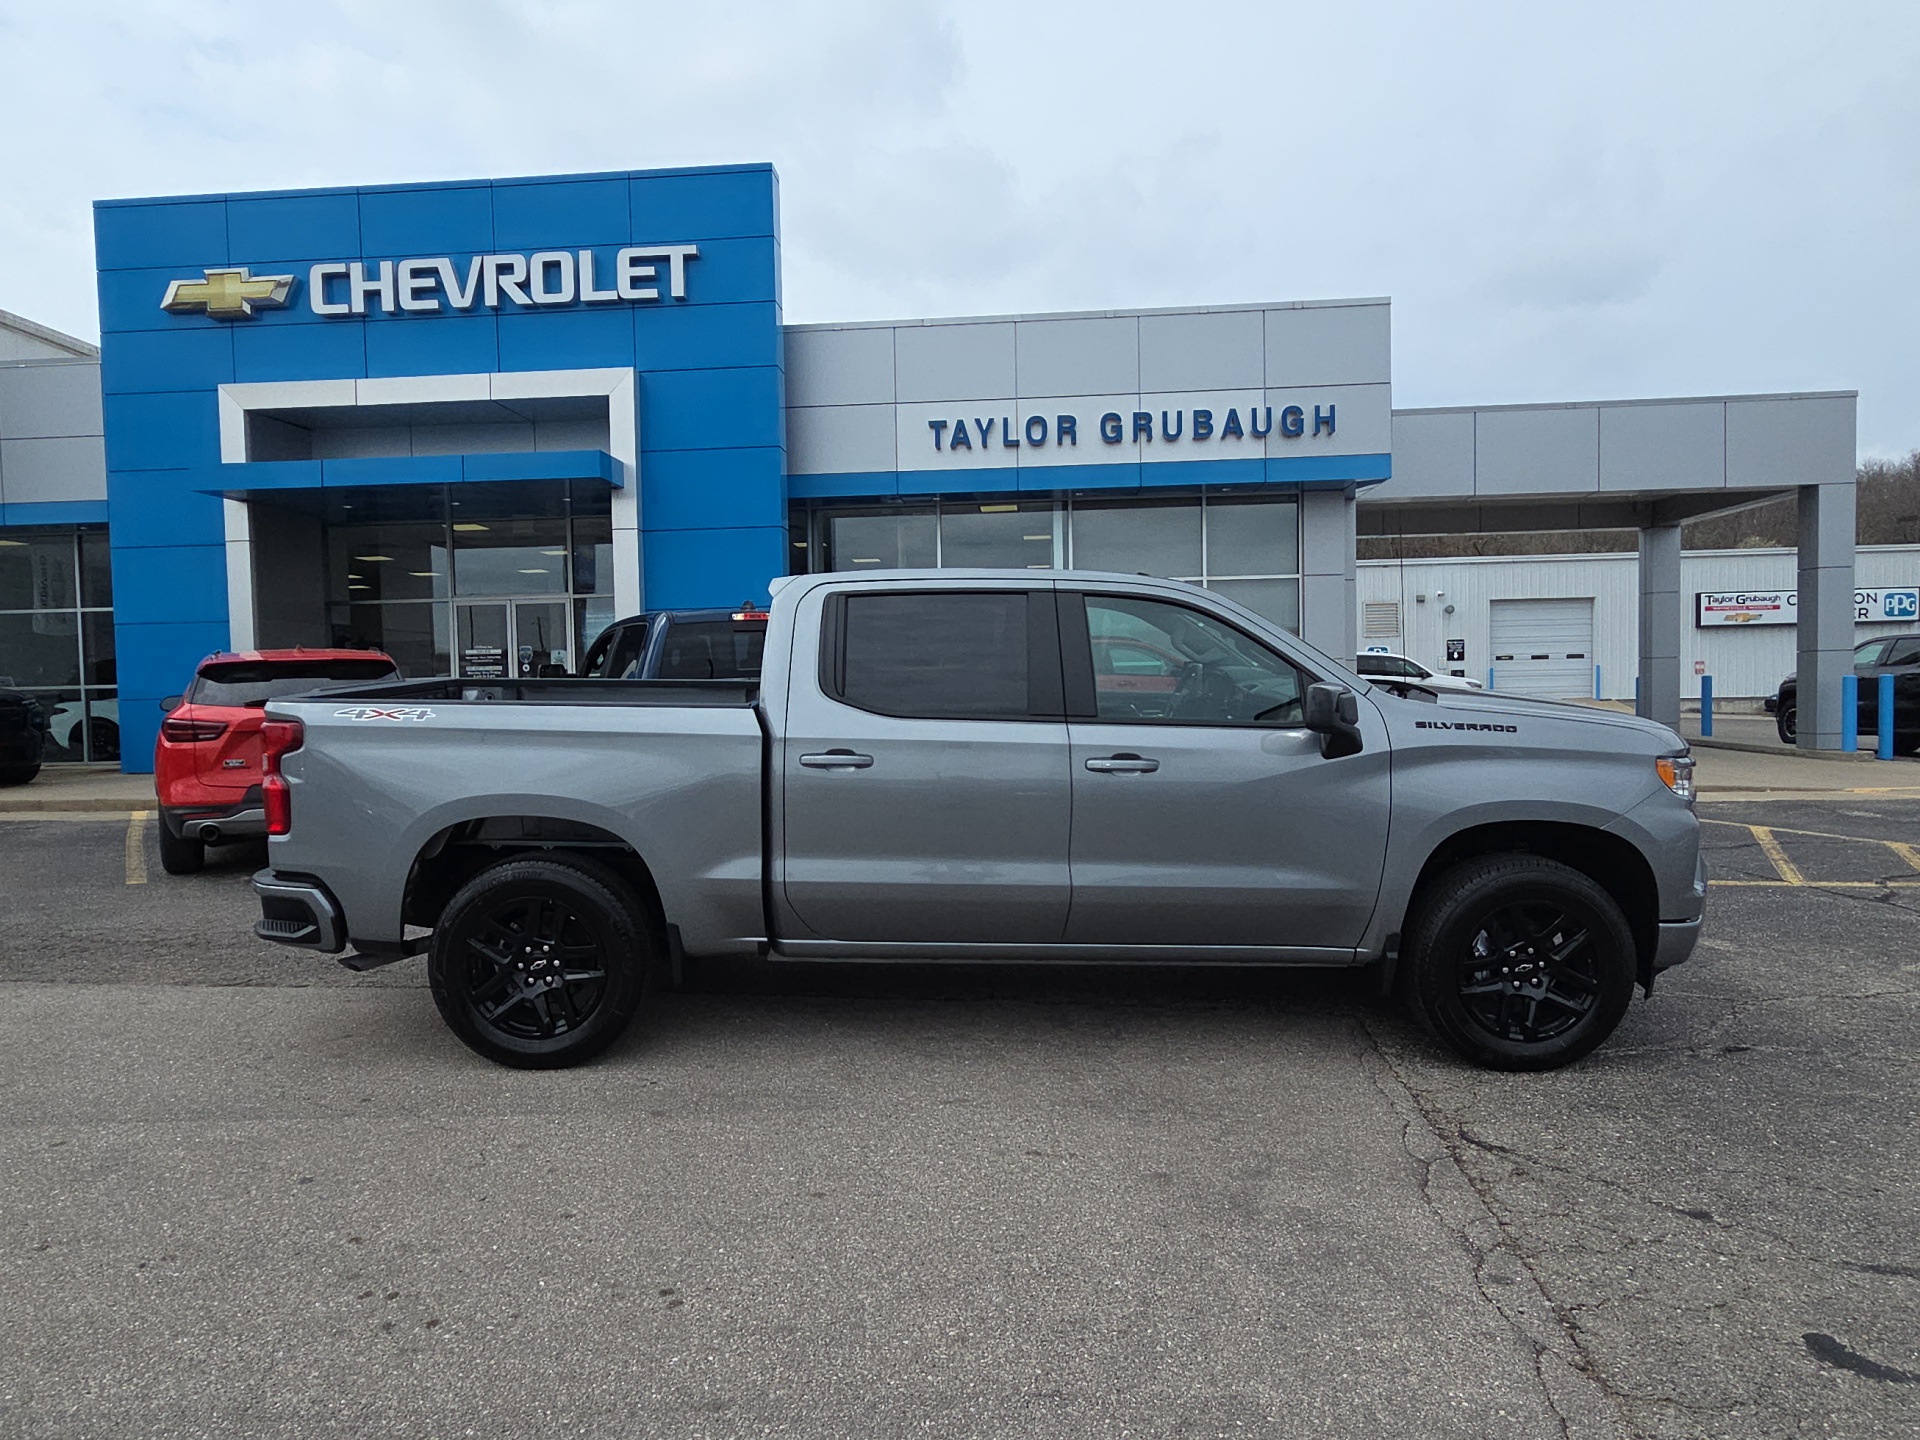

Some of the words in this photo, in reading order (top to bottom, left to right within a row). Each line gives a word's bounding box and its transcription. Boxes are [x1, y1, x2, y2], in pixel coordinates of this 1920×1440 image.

[309, 244, 698, 316] CHEVROLET
[927, 414, 1078, 451] TAYLOR
[1099, 404, 1337, 444] GRUBAUGH
[1704, 594, 1735, 605] Taylor
[1736, 593, 1781, 605] Grubaugh
[1885, 594, 1916, 615] PPG
[333, 707, 437, 721] 4X4
[1414, 721, 1518, 733] SILVERADO
